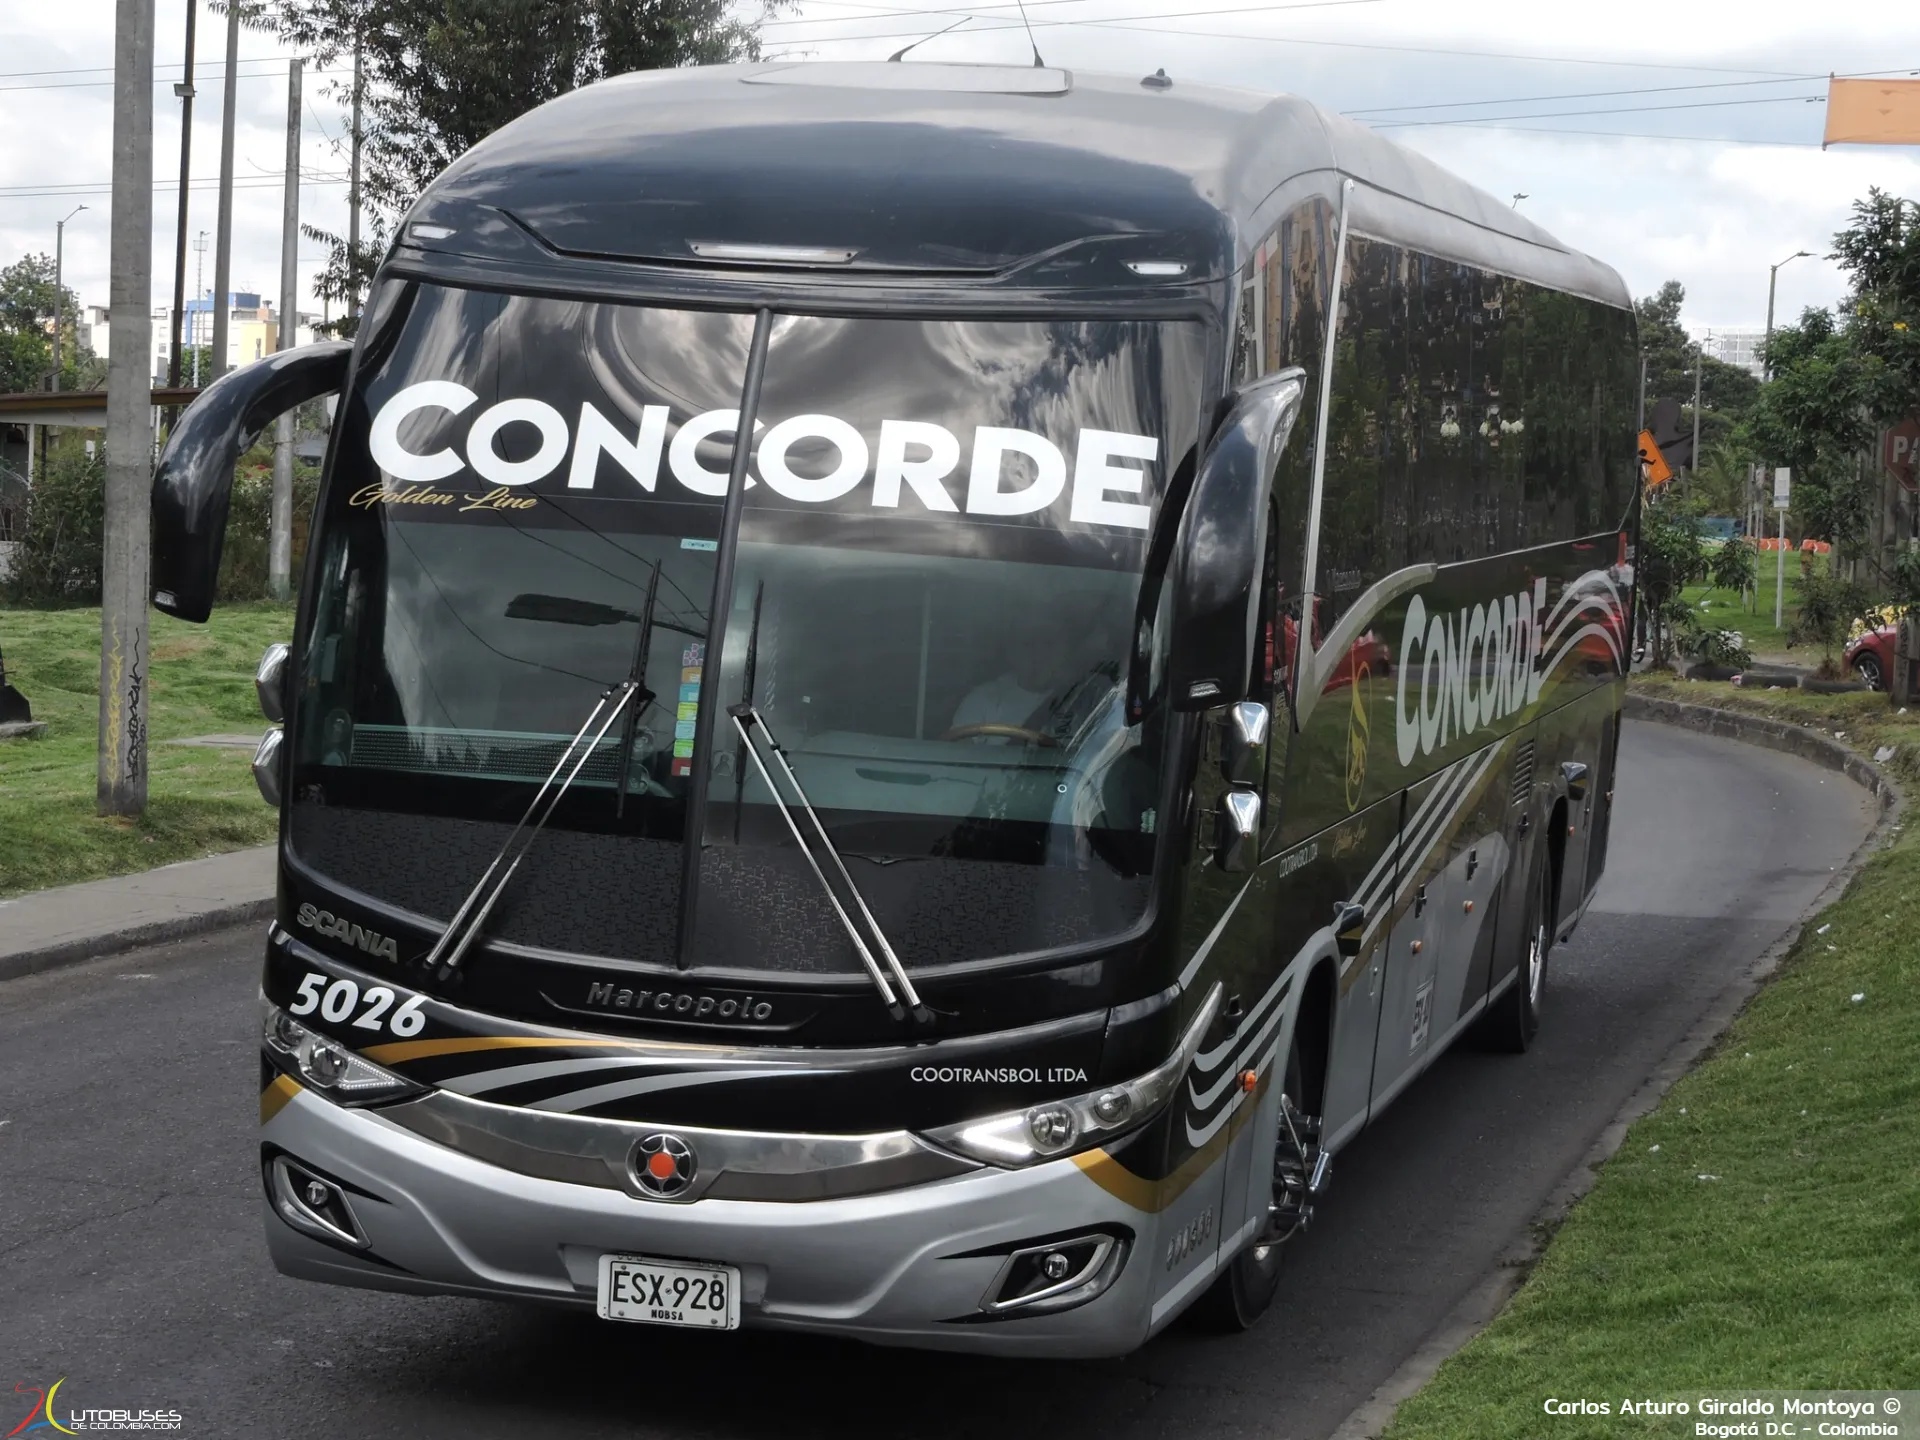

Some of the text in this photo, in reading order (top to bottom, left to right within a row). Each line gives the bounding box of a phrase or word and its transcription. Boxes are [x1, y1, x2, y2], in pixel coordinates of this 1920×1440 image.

[369, 380, 1159, 530] CONCORDE
[349, 482, 537, 512] Golden Line
[1396, 576, 1547, 768] CONCORDE
[297, 902, 398, 963] SCANIA
[289, 972, 426, 1037] 5026
[586, 982, 772, 1020] Marcopolo
[910, 1067, 1088, 1083] COOTRANSBOL LTDA
[651, 1309, 684, 1321] NOBSA
